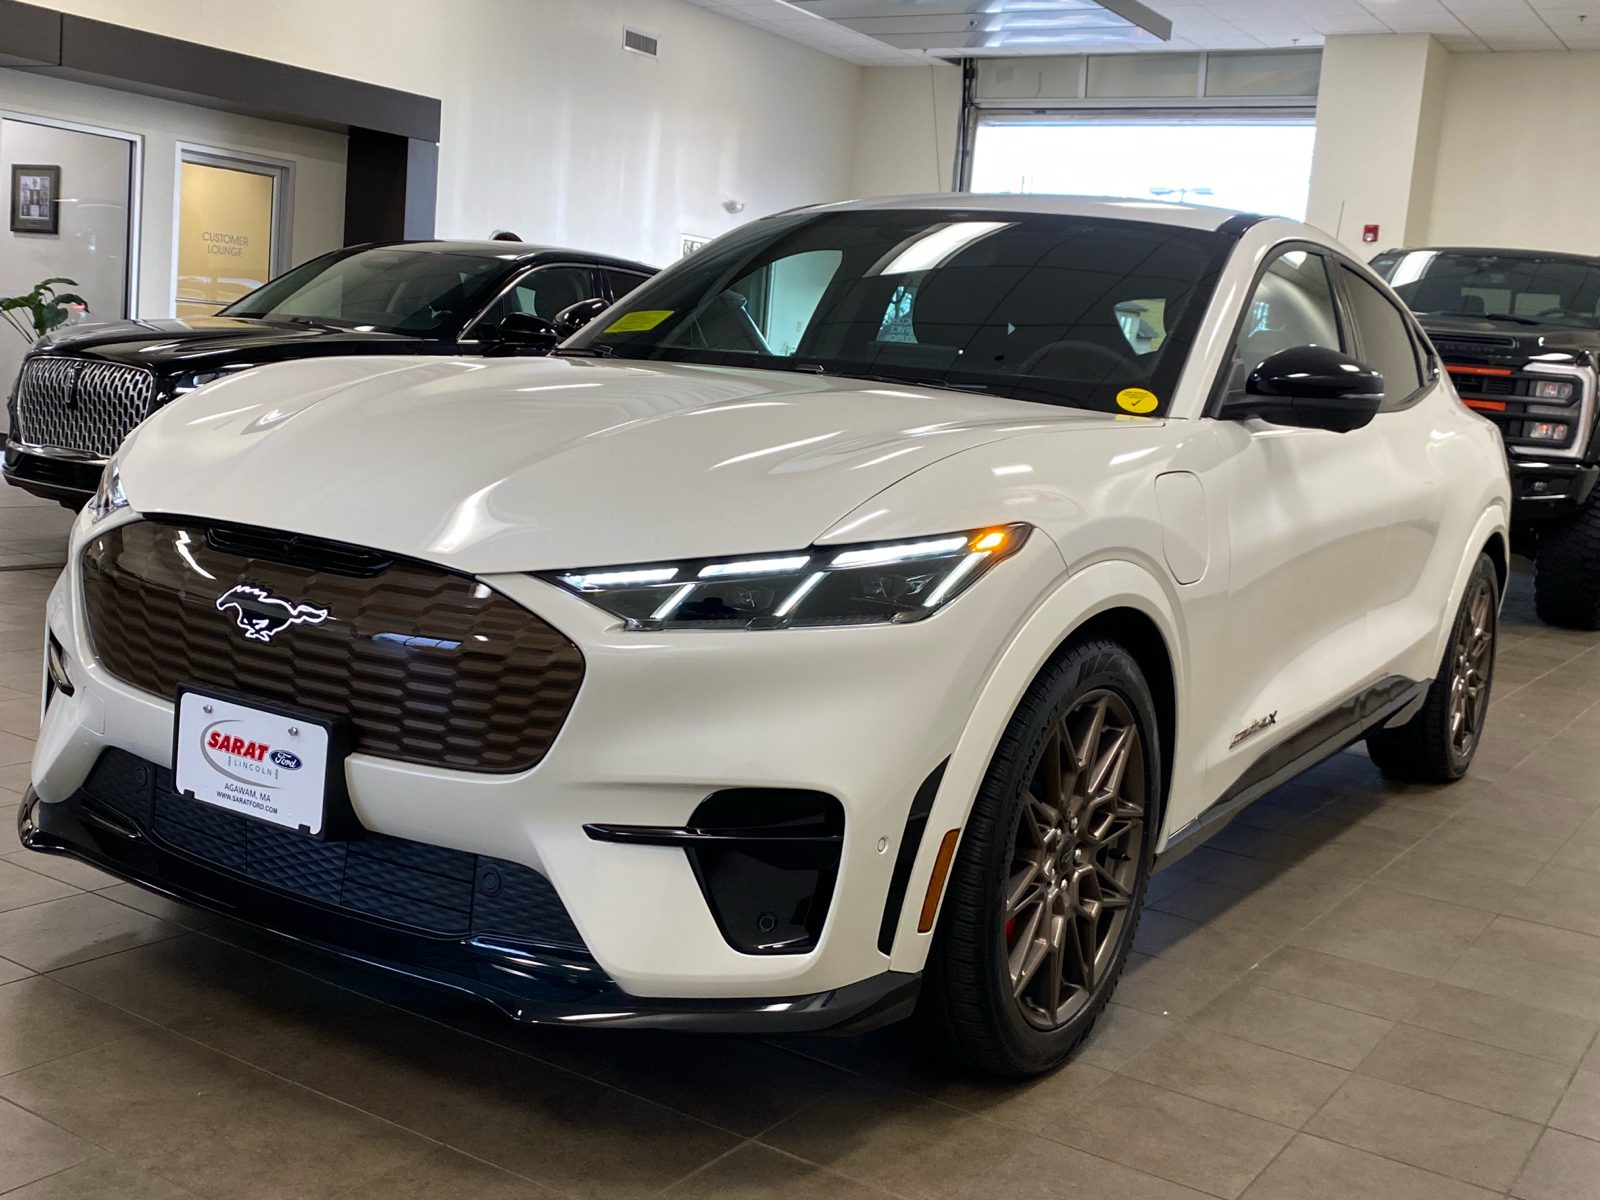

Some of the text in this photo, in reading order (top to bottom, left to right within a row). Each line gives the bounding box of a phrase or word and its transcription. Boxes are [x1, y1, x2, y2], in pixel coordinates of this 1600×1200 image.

[202, 231, 249, 246] CUSTOMER
[207, 245, 243, 257] LOUNGE
[207, 730, 298, 768] SARAT Ford
[234, 759, 272, 775] LINCOLN
[224, 782, 271, 802] AGAWAM, MA
[216, 790, 278, 815] WWW.SARATFORD.COM
